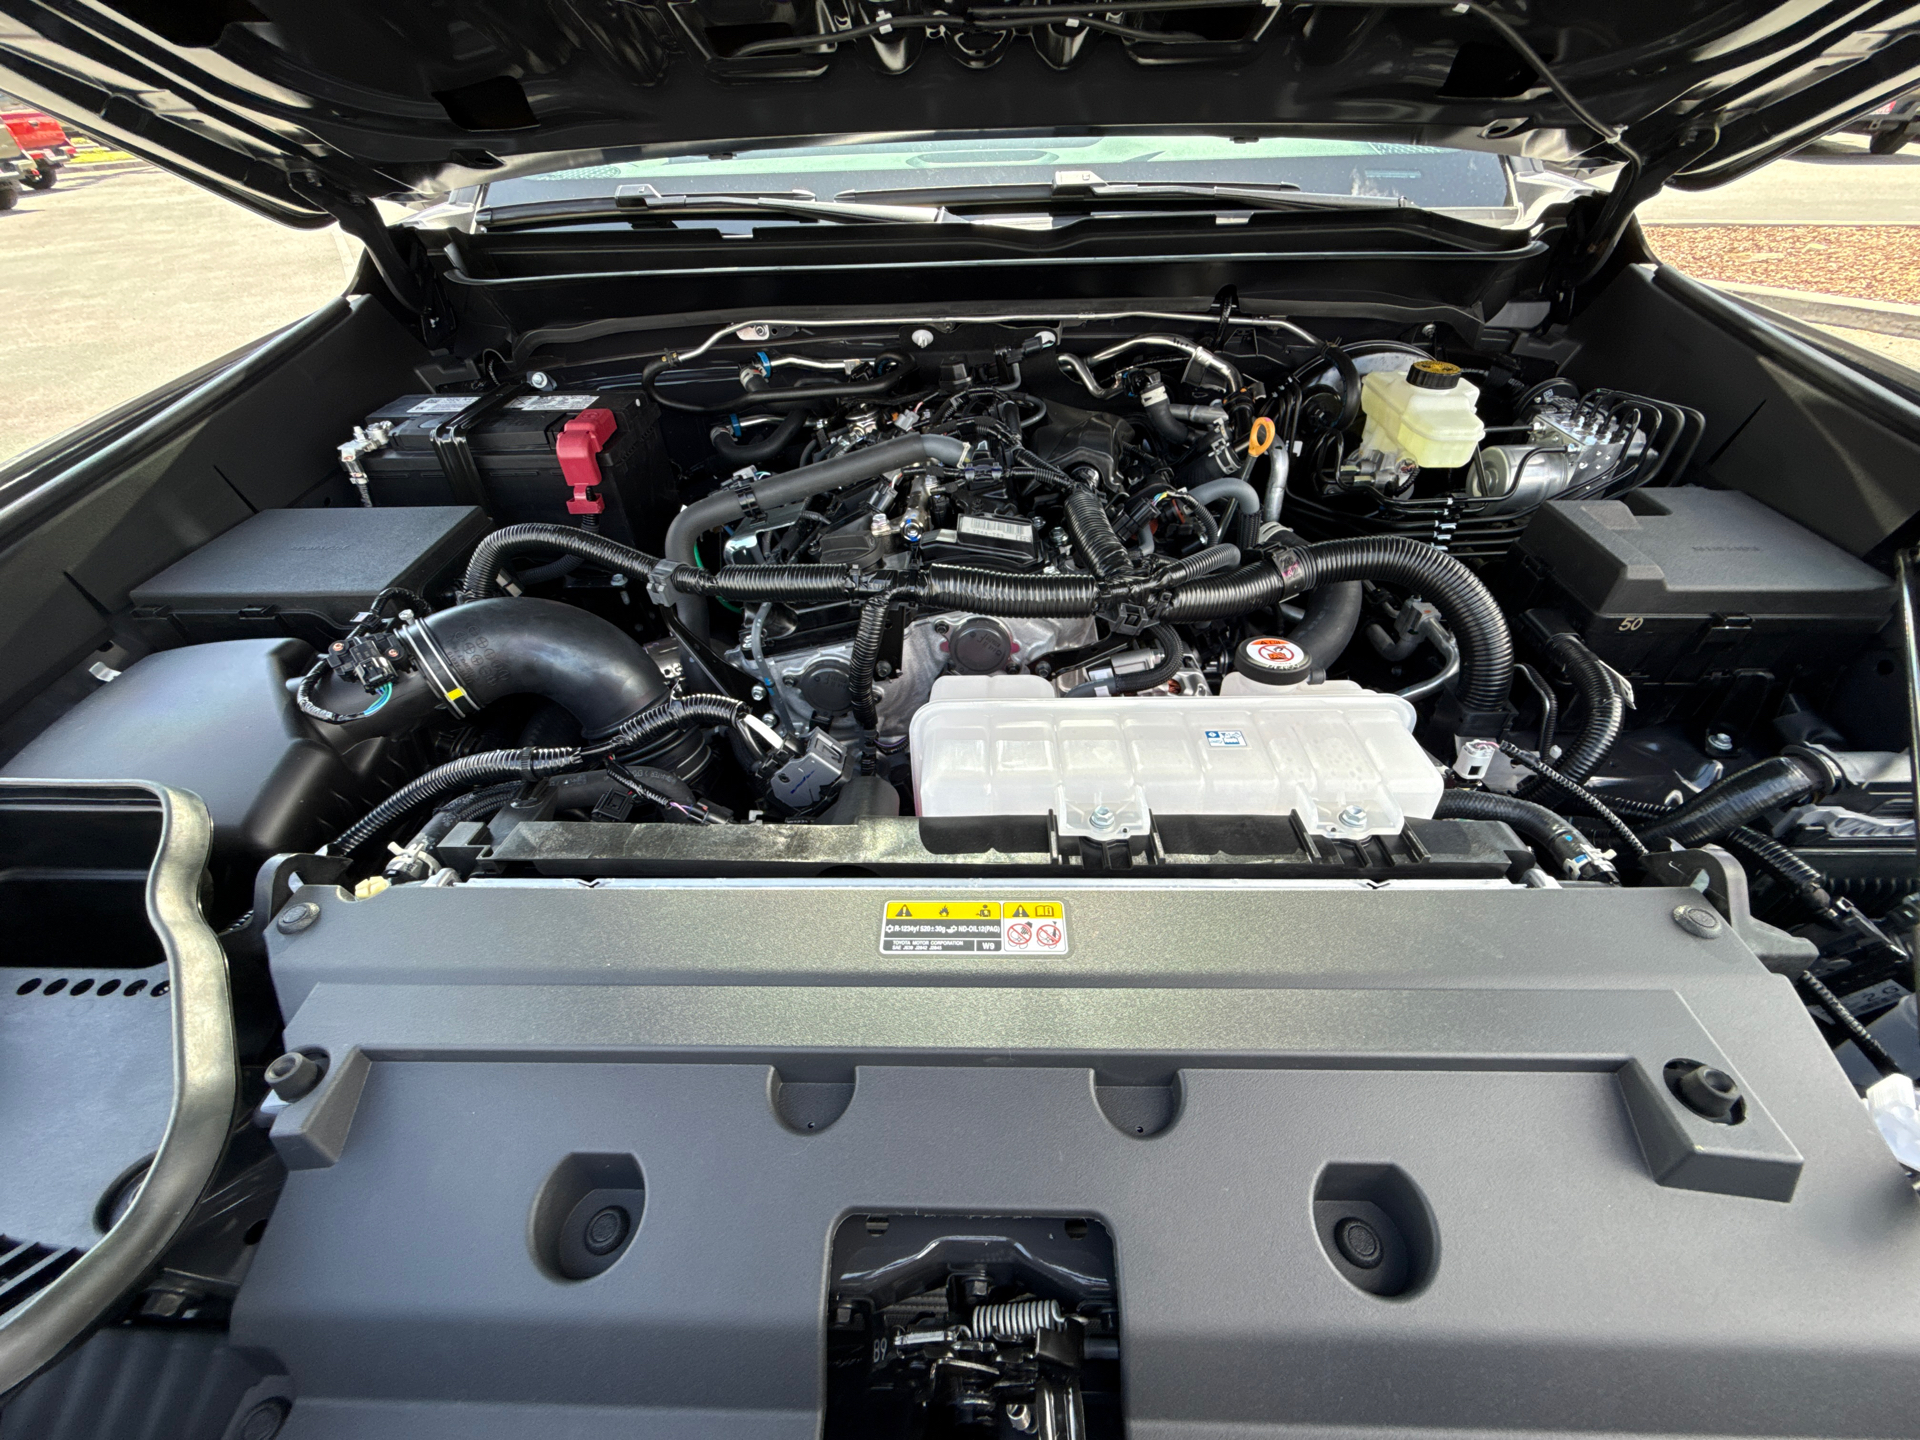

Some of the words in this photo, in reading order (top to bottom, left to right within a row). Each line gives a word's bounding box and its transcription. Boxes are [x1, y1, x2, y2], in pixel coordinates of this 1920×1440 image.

[1618, 616, 1644, 631] 50
[894, 925, 919, 934] R-1234yf
[982, 942, 995, 950] W9
